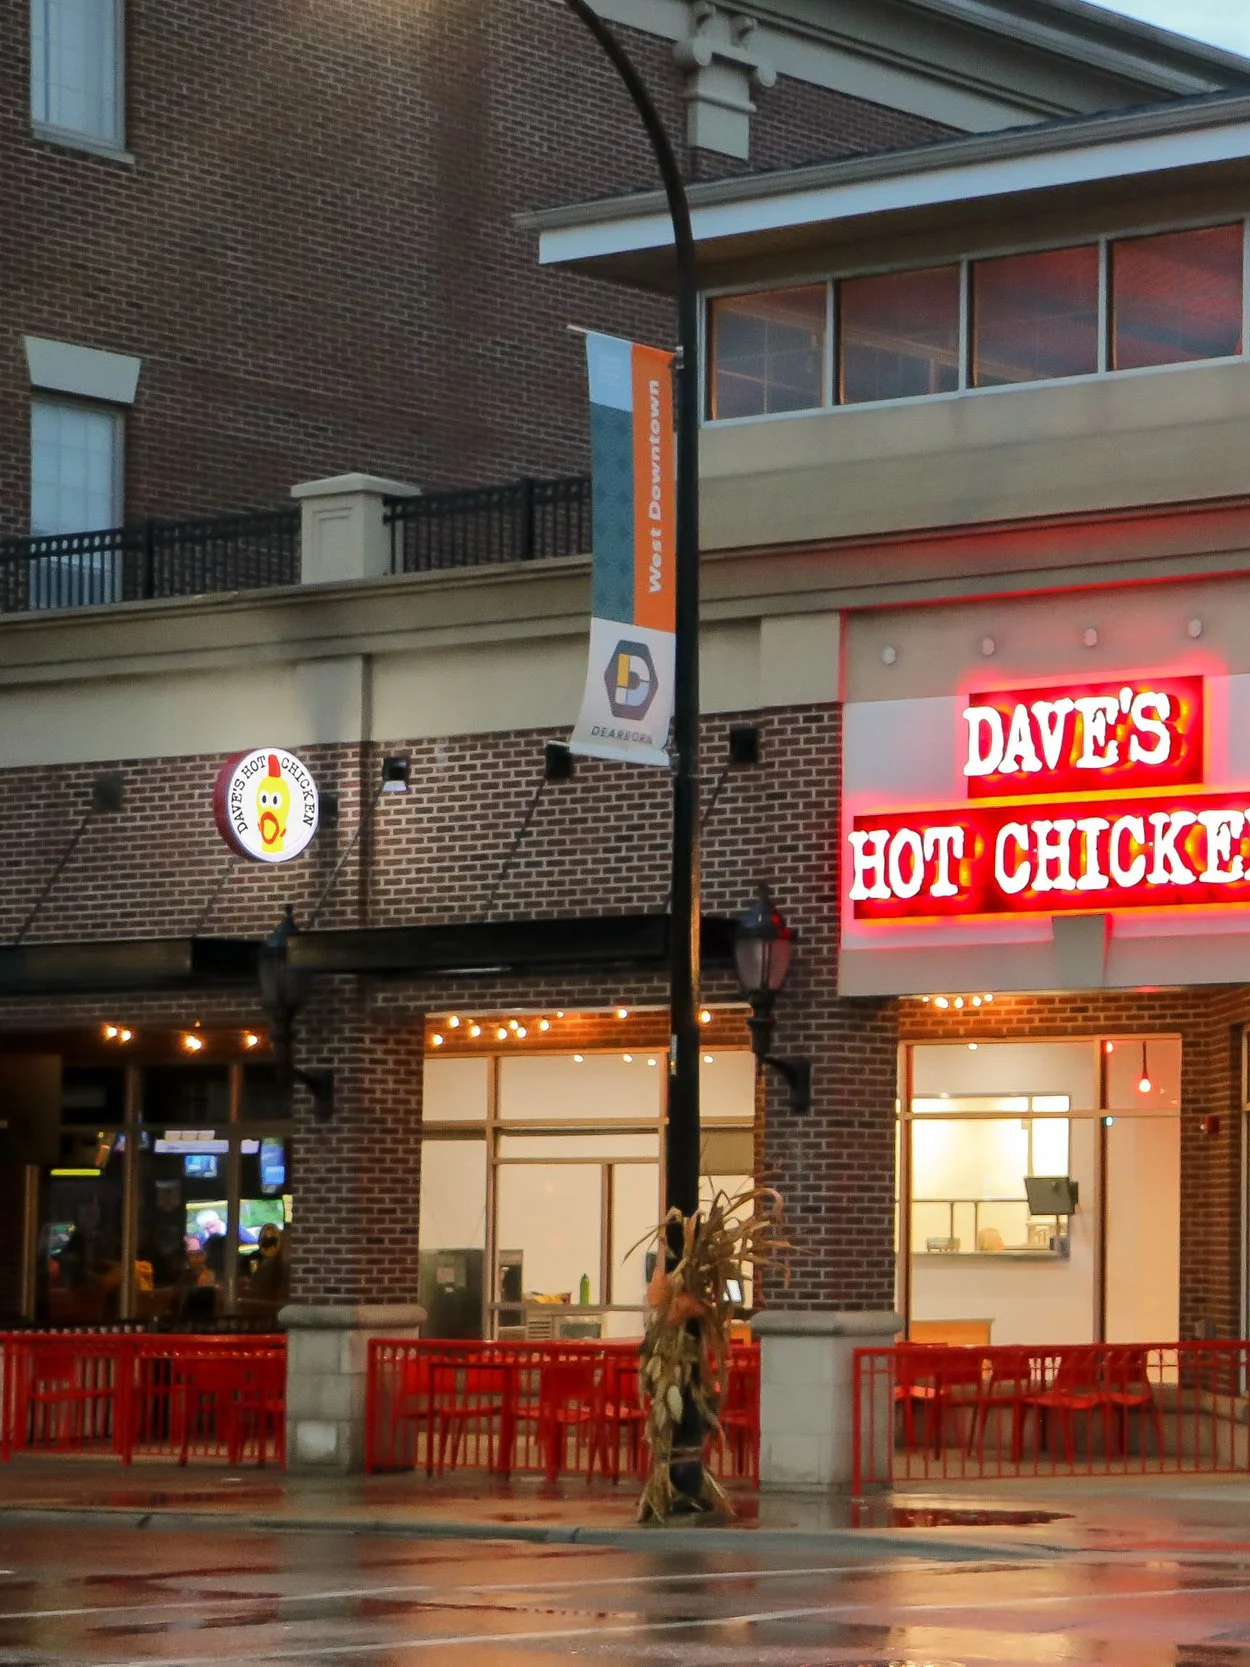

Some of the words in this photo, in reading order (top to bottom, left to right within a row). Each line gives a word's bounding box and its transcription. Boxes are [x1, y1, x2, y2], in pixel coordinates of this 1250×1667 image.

[648, 380, 662, 521] Downtown
[648, 528, 663, 593] West
[591, 725, 653, 745] DEARBORN
[962, 687, 1172, 777] DAVE'S
[231, 778, 249, 835] DAVE'S
[241, 755, 266, 779] HOT
[280, 757, 316, 828] CHICKEN
[848, 826, 965, 901] HOT
